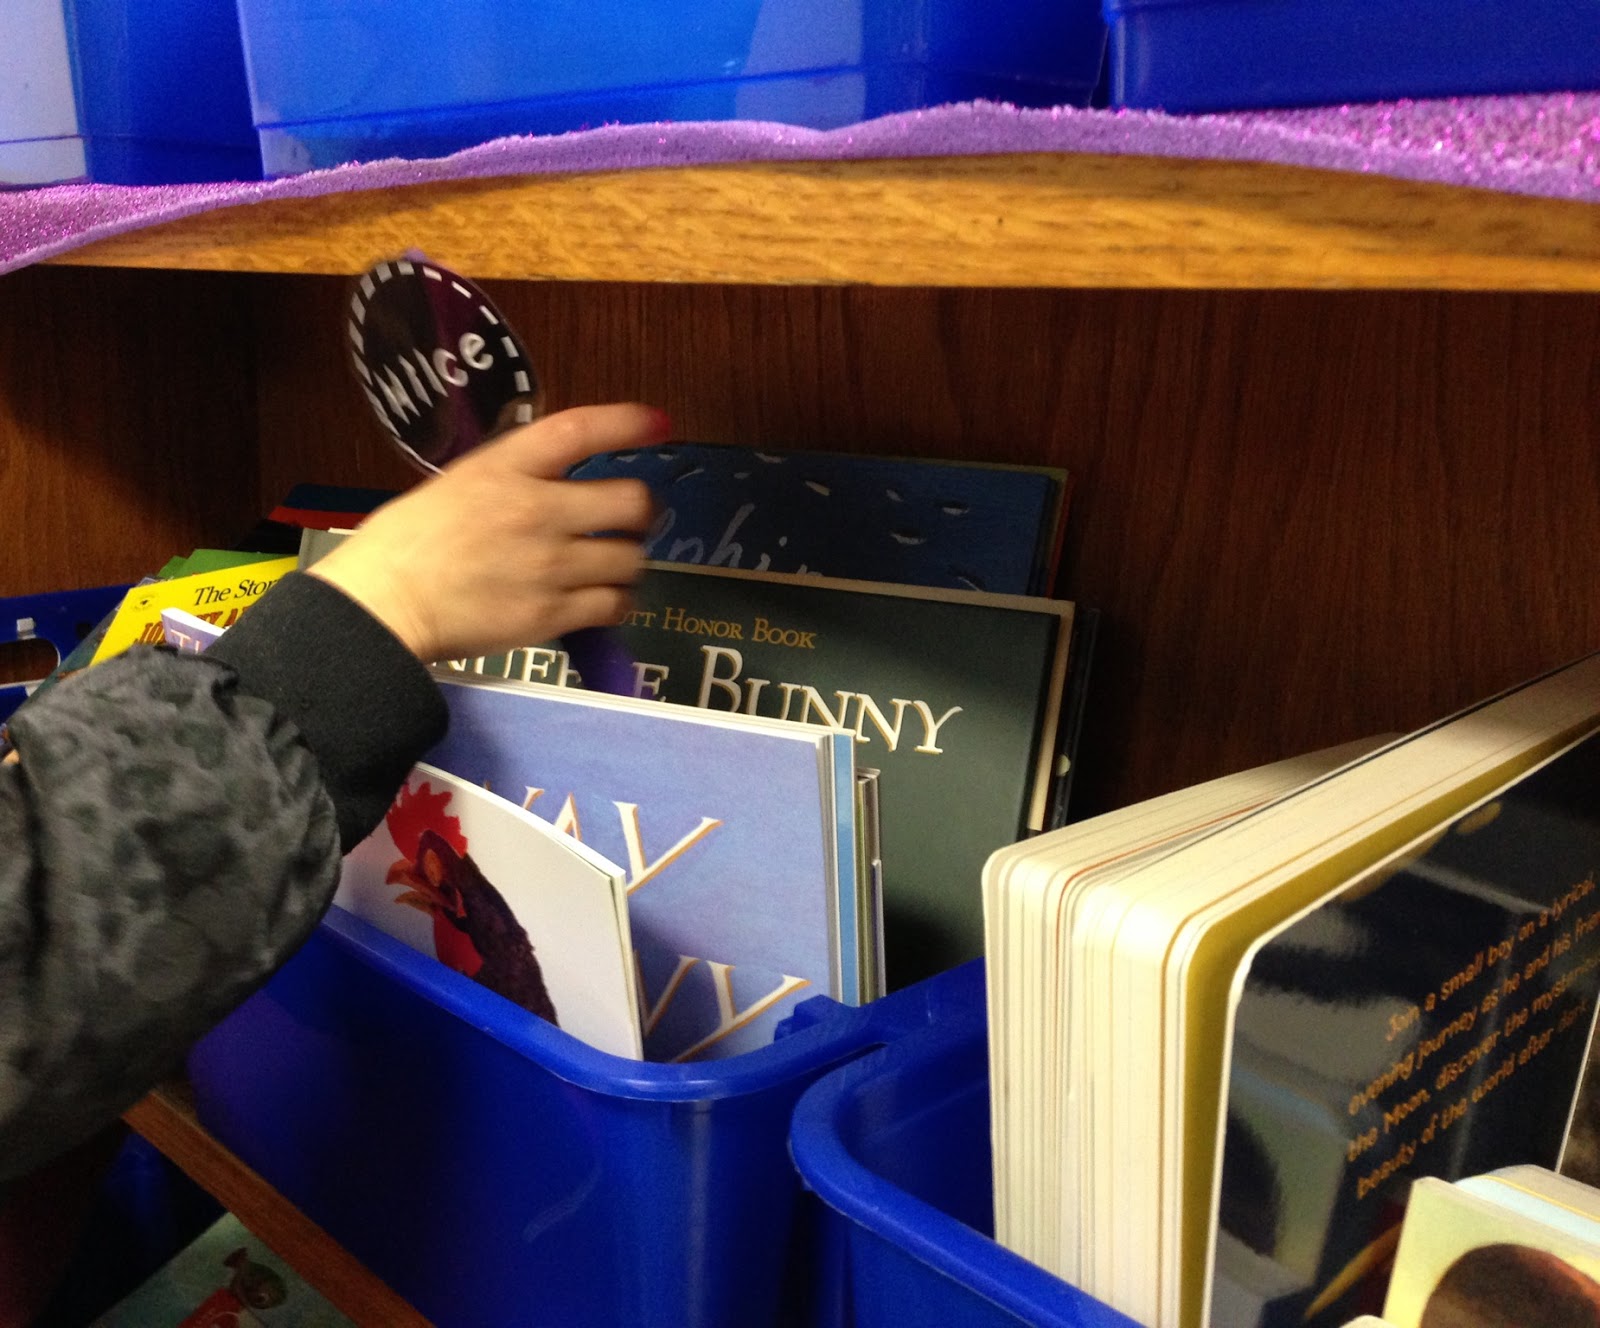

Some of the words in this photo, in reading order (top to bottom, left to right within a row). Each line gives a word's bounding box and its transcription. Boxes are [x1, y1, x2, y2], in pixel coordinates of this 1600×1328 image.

[194, 585, 232, 607] The
[234, 578, 281, 599] Stor
[662, 607, 744, 640] HONOR
[752, 617, 816, 650] BOOK
[698, 644, 963, 755] BUNNY
[1416, 1006, 1478, 1069] journey
[1481, 988, 1499, 1013] as
[1524, 945, 1549, 980] and
[1425, 992, 1436, 1012] a
[1441, 952, 1484, 1000] small
[1488, 935, 1515, 967] boy
[1519, 920, 1535, 941] on
[1347, 1127, 1378, 1162] the
[1436, 1030, 1500, 1090] discover
[1504, 1008, 1529, 1037] the
[1357, 1139, 1417, 1200] beauty
[1421, 1113, 1439, 1144] of
[1441, 1098, 1468, 1129] the
[1472, 1053, 1515, 1103] world
[1519, 1028, 1554, 1065] after
